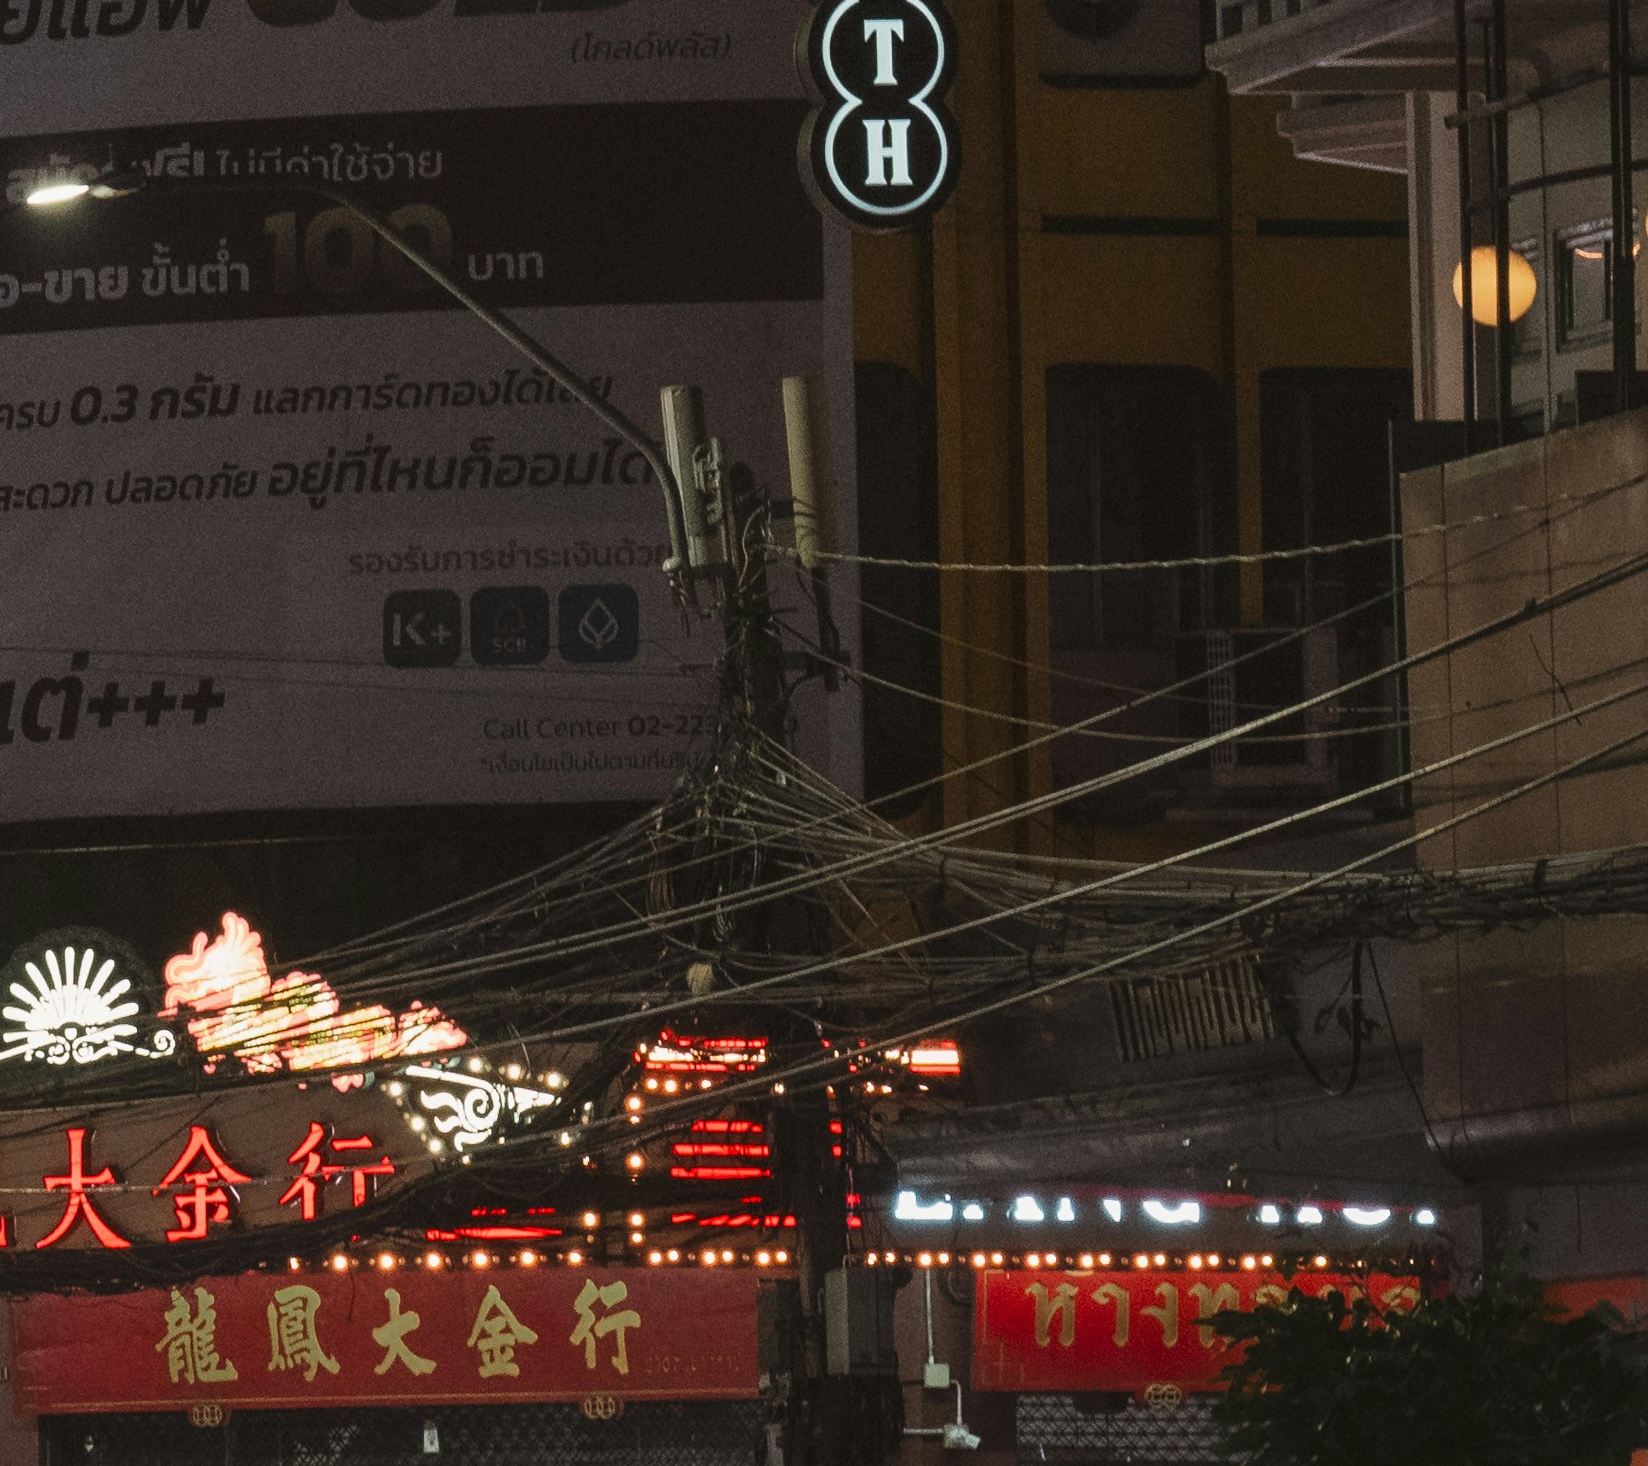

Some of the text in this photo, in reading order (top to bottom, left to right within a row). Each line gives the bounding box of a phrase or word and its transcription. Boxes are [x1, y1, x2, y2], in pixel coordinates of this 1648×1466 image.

[468, 243, 546, 285] บาท
[70, 385, 138, 425] 0.3
[153, 1278, 642, 1384] 龍鳳大金行
